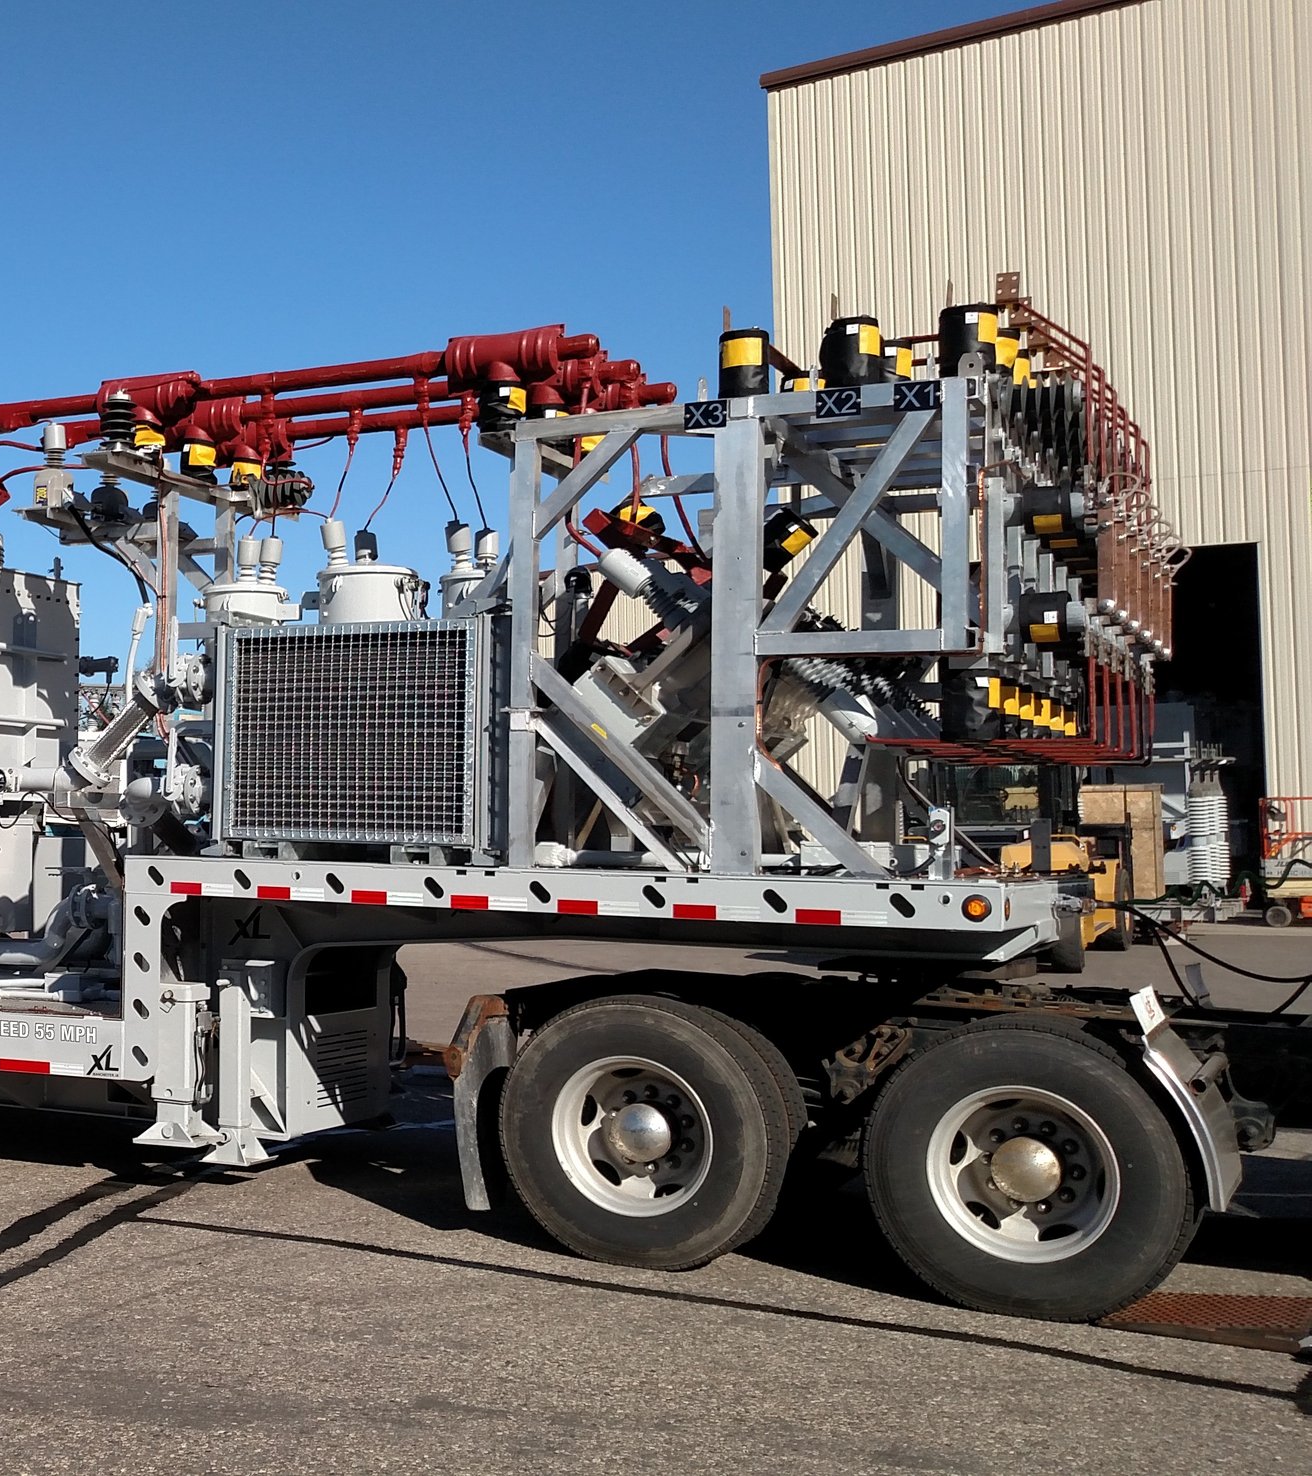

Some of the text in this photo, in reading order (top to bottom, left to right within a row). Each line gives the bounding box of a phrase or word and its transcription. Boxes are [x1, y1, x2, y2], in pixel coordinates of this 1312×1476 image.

[819, 390, 858, 416] X2
[897, 384, 936, 409] X1
[687, 402, 724, 428] X3
[227, 905, 271, 946] XL
[34, 1023, 55, 1040] 55
[60, 1024, 97, 1043] MPH
[86, 1044, 119, 1075] XL
